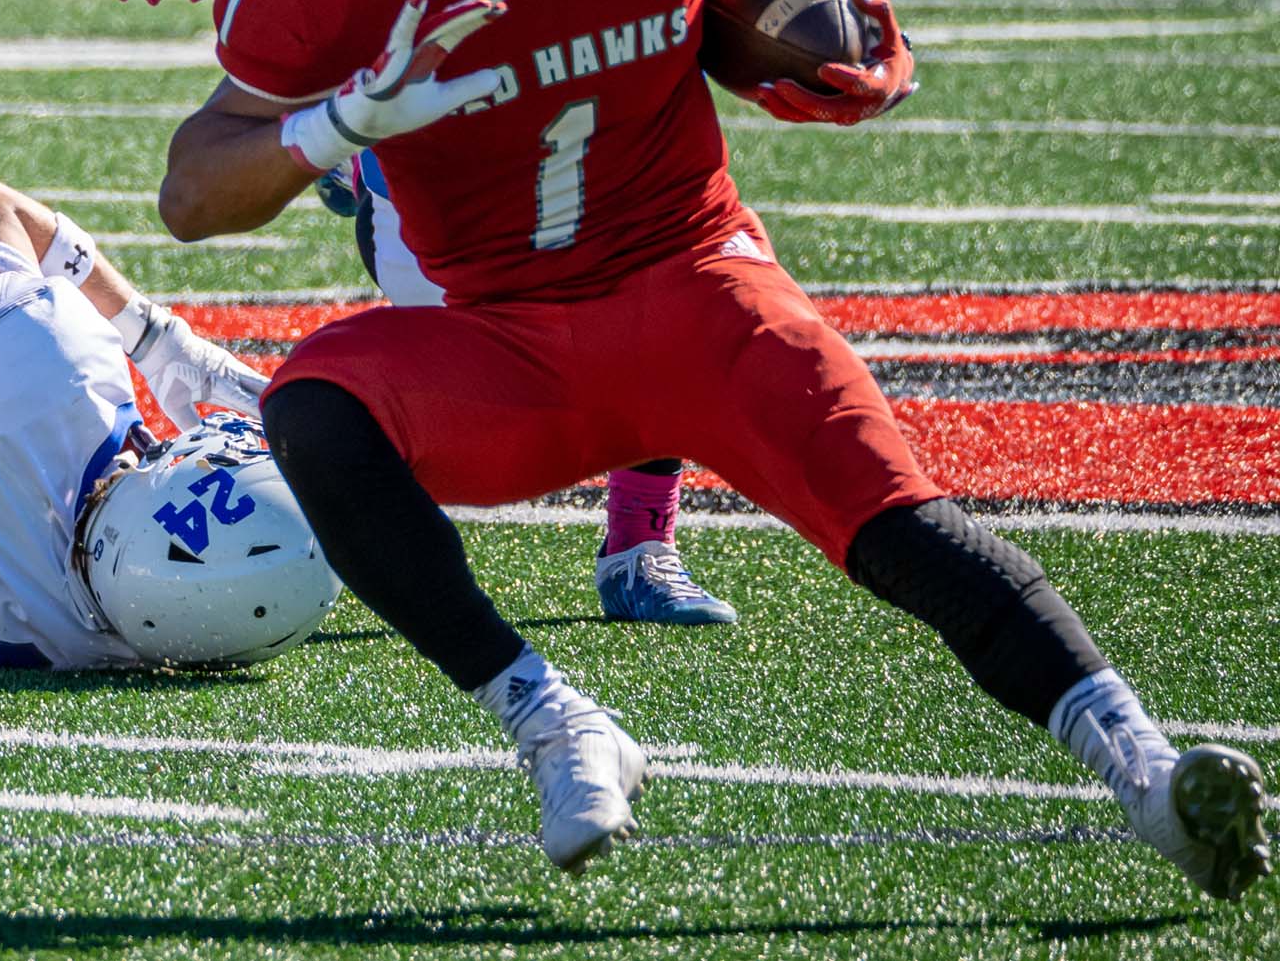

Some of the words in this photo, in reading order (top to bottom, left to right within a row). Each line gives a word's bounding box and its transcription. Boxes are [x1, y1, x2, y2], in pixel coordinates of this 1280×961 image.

[532, 6, 687, 87] HAWKS
[531, 95, 600, 251] 1
[153, 467, 256, 556] 24
